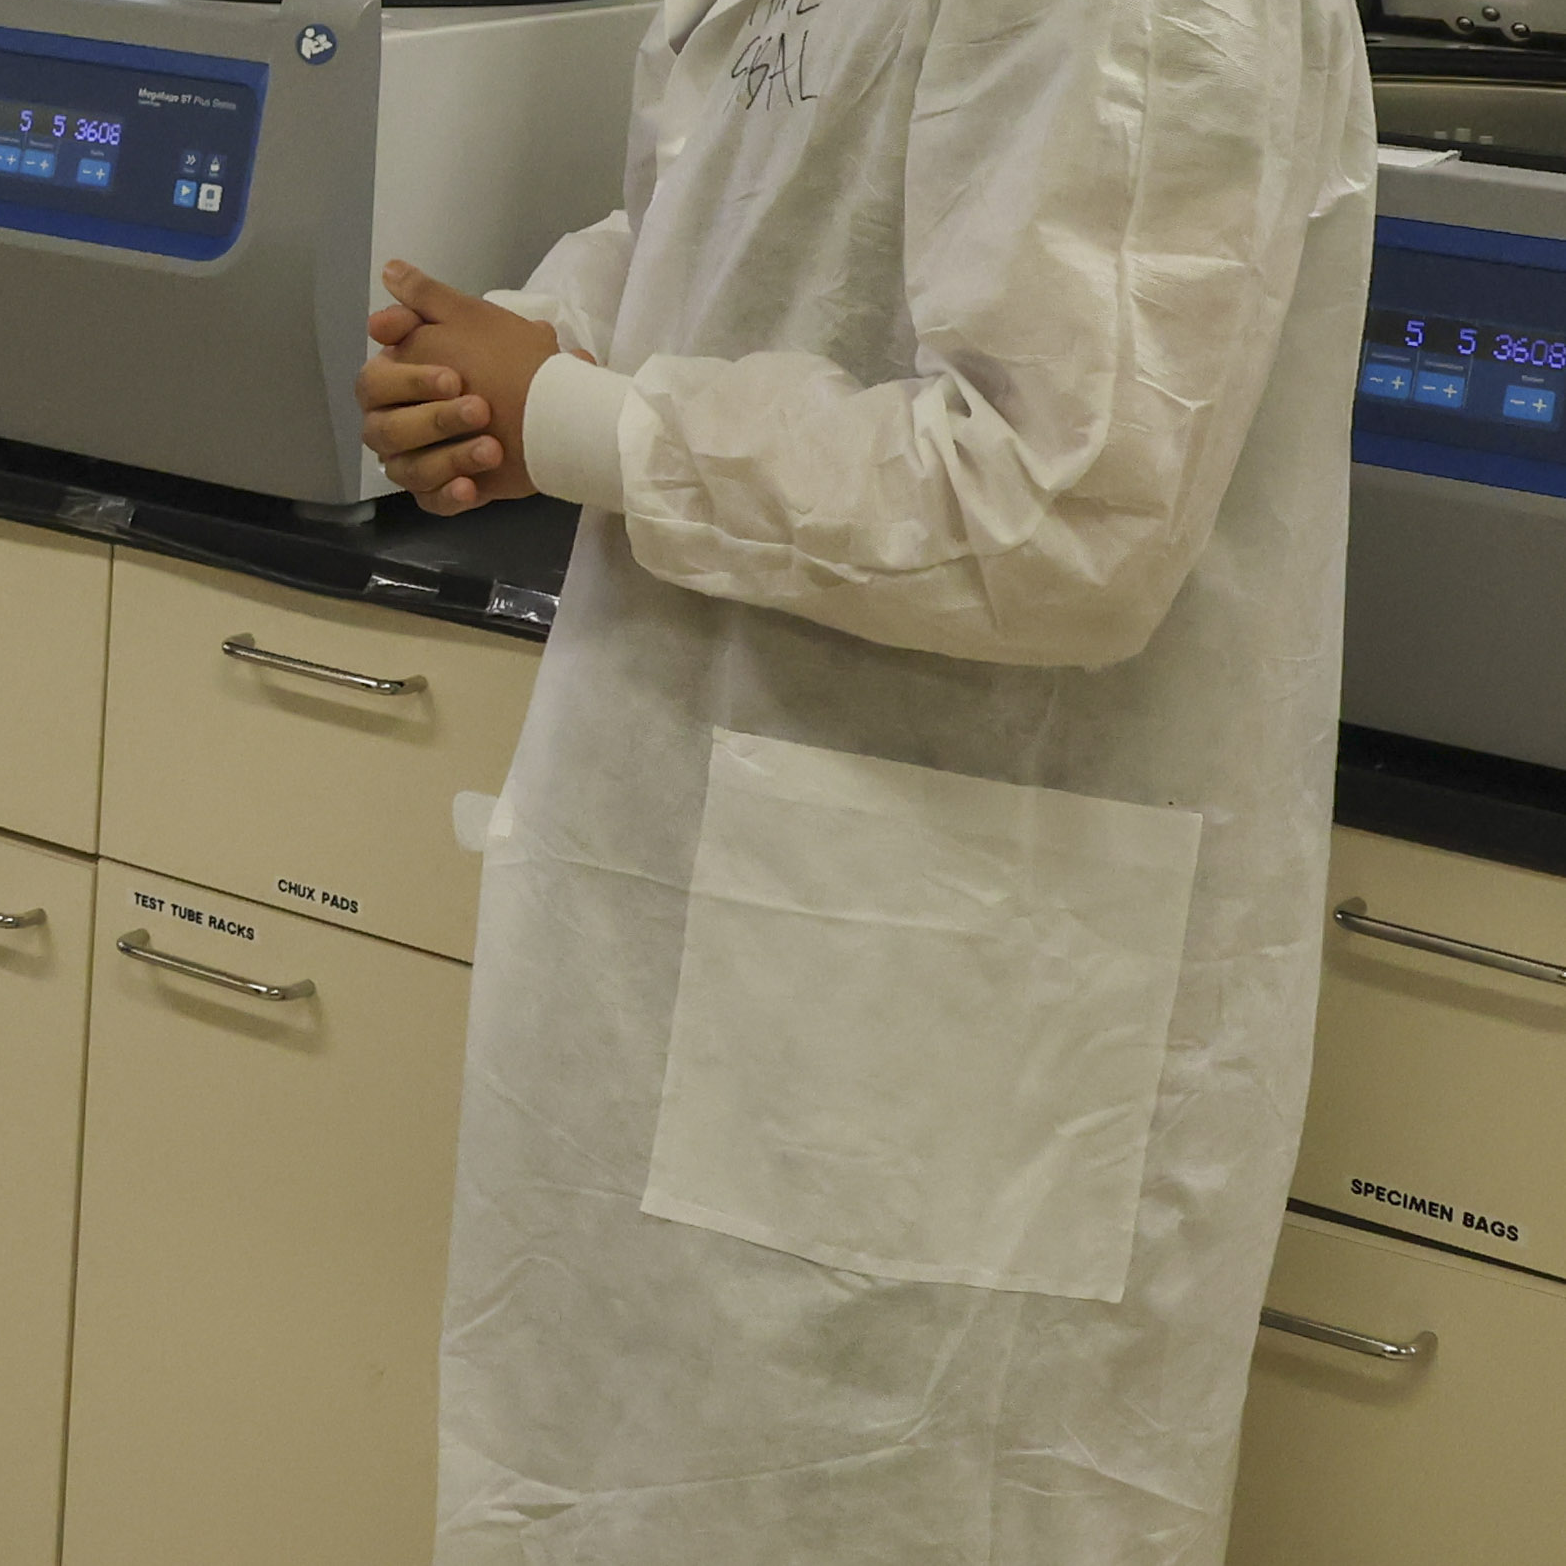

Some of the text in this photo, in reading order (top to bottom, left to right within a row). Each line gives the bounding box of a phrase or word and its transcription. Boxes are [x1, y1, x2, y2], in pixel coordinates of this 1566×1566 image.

[20, 110, 33, 131] 5
[52, 115, 67, 136] 5
[74, 119, 122, 145] 3608
[1404, 320, 1566, 370] 5 5 3608
[134, 892, 255, 941] TEST TUBE RACKS
[277, 878, 359, 914] CHUX PADS
[1350, 1178, 1519, 1242] SPECIMEN BAGS
